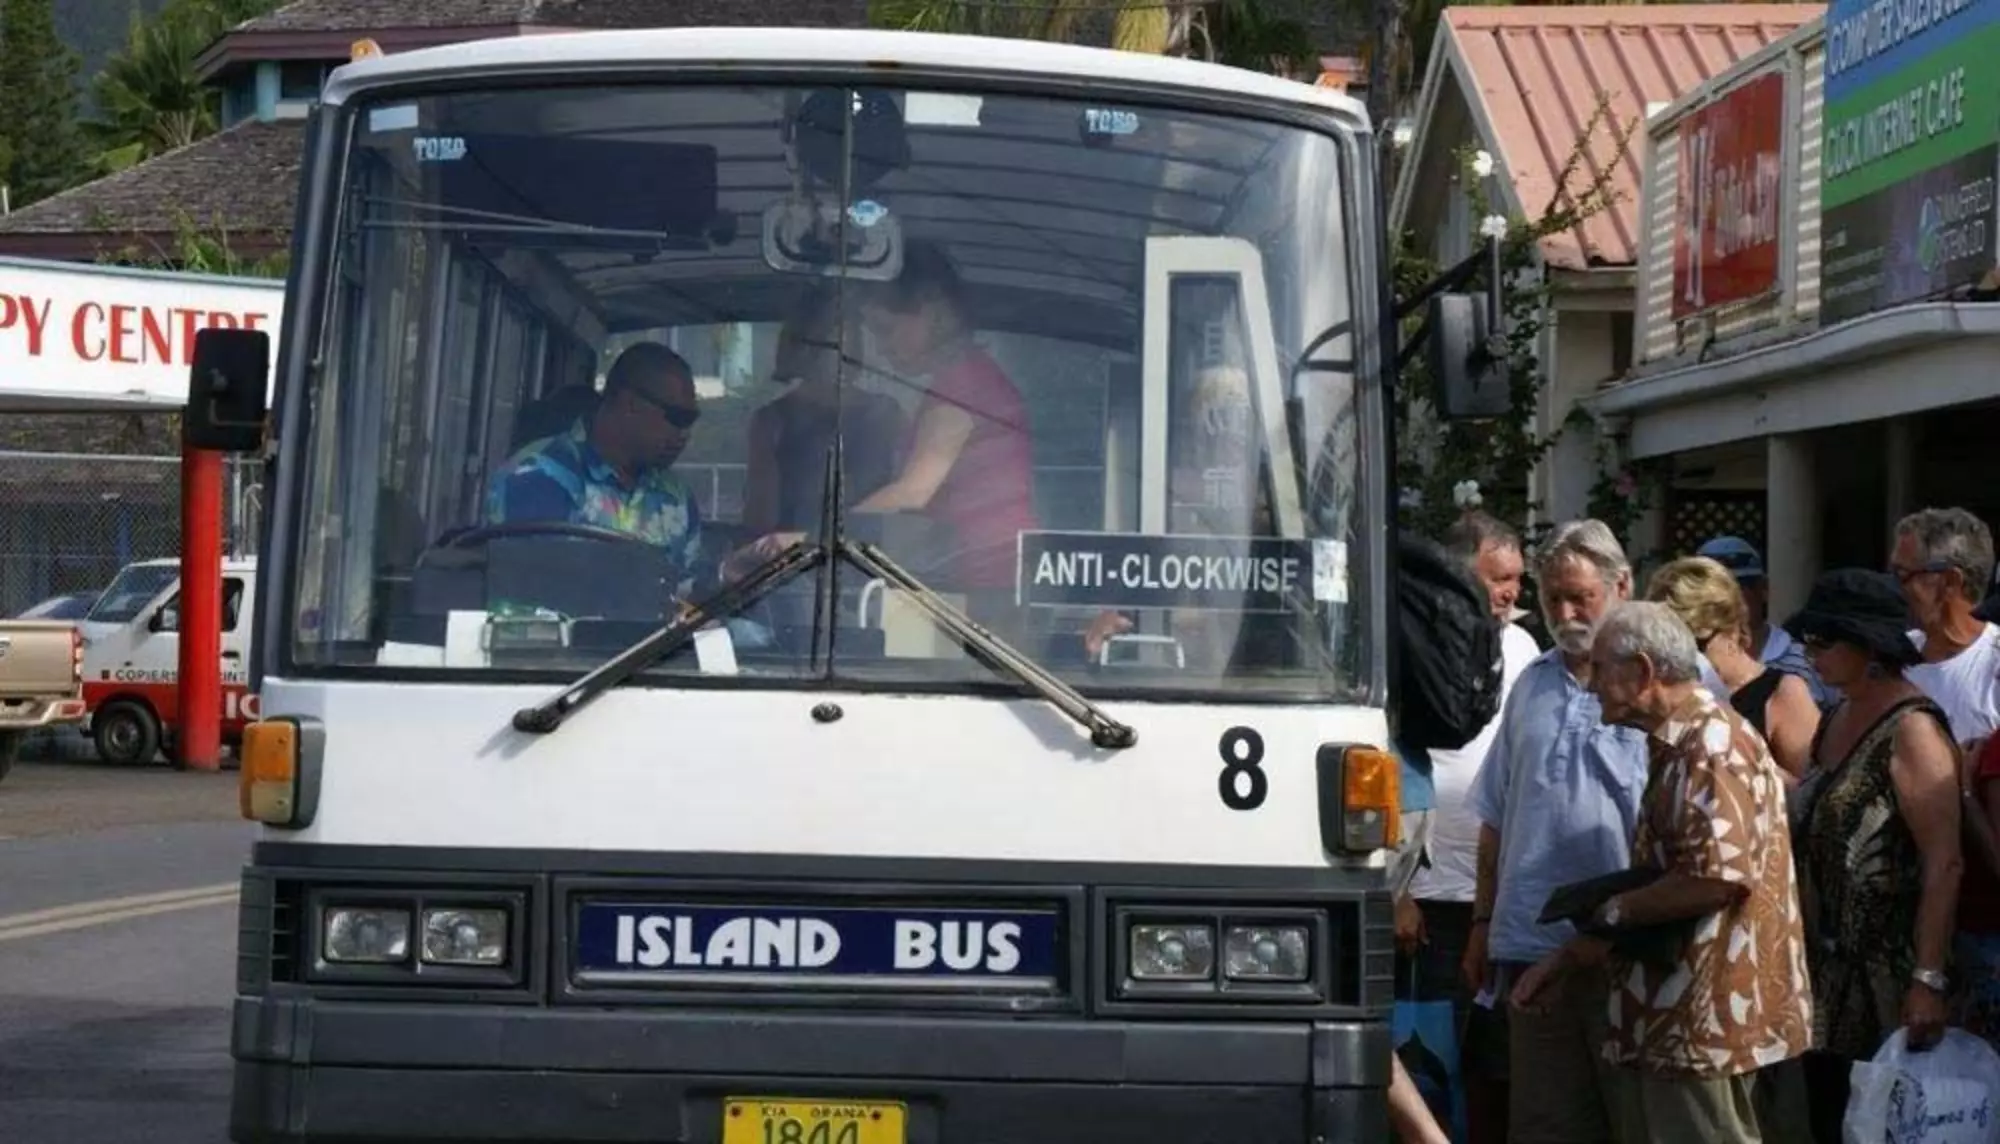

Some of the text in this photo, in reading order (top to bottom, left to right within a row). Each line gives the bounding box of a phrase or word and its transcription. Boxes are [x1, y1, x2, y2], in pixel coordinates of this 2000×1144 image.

[1864, 87, 1923, 163] INTERNET
[1927, 67, 1964, 135] CAFE
[71, 301, 269, 365] CENT
[1034, 551, 1299, 592] ANTI-CLOCKWISE
[1218, 725, 1268, 811] 8
[616, 914, 1022, 973] ISLAND BUS
